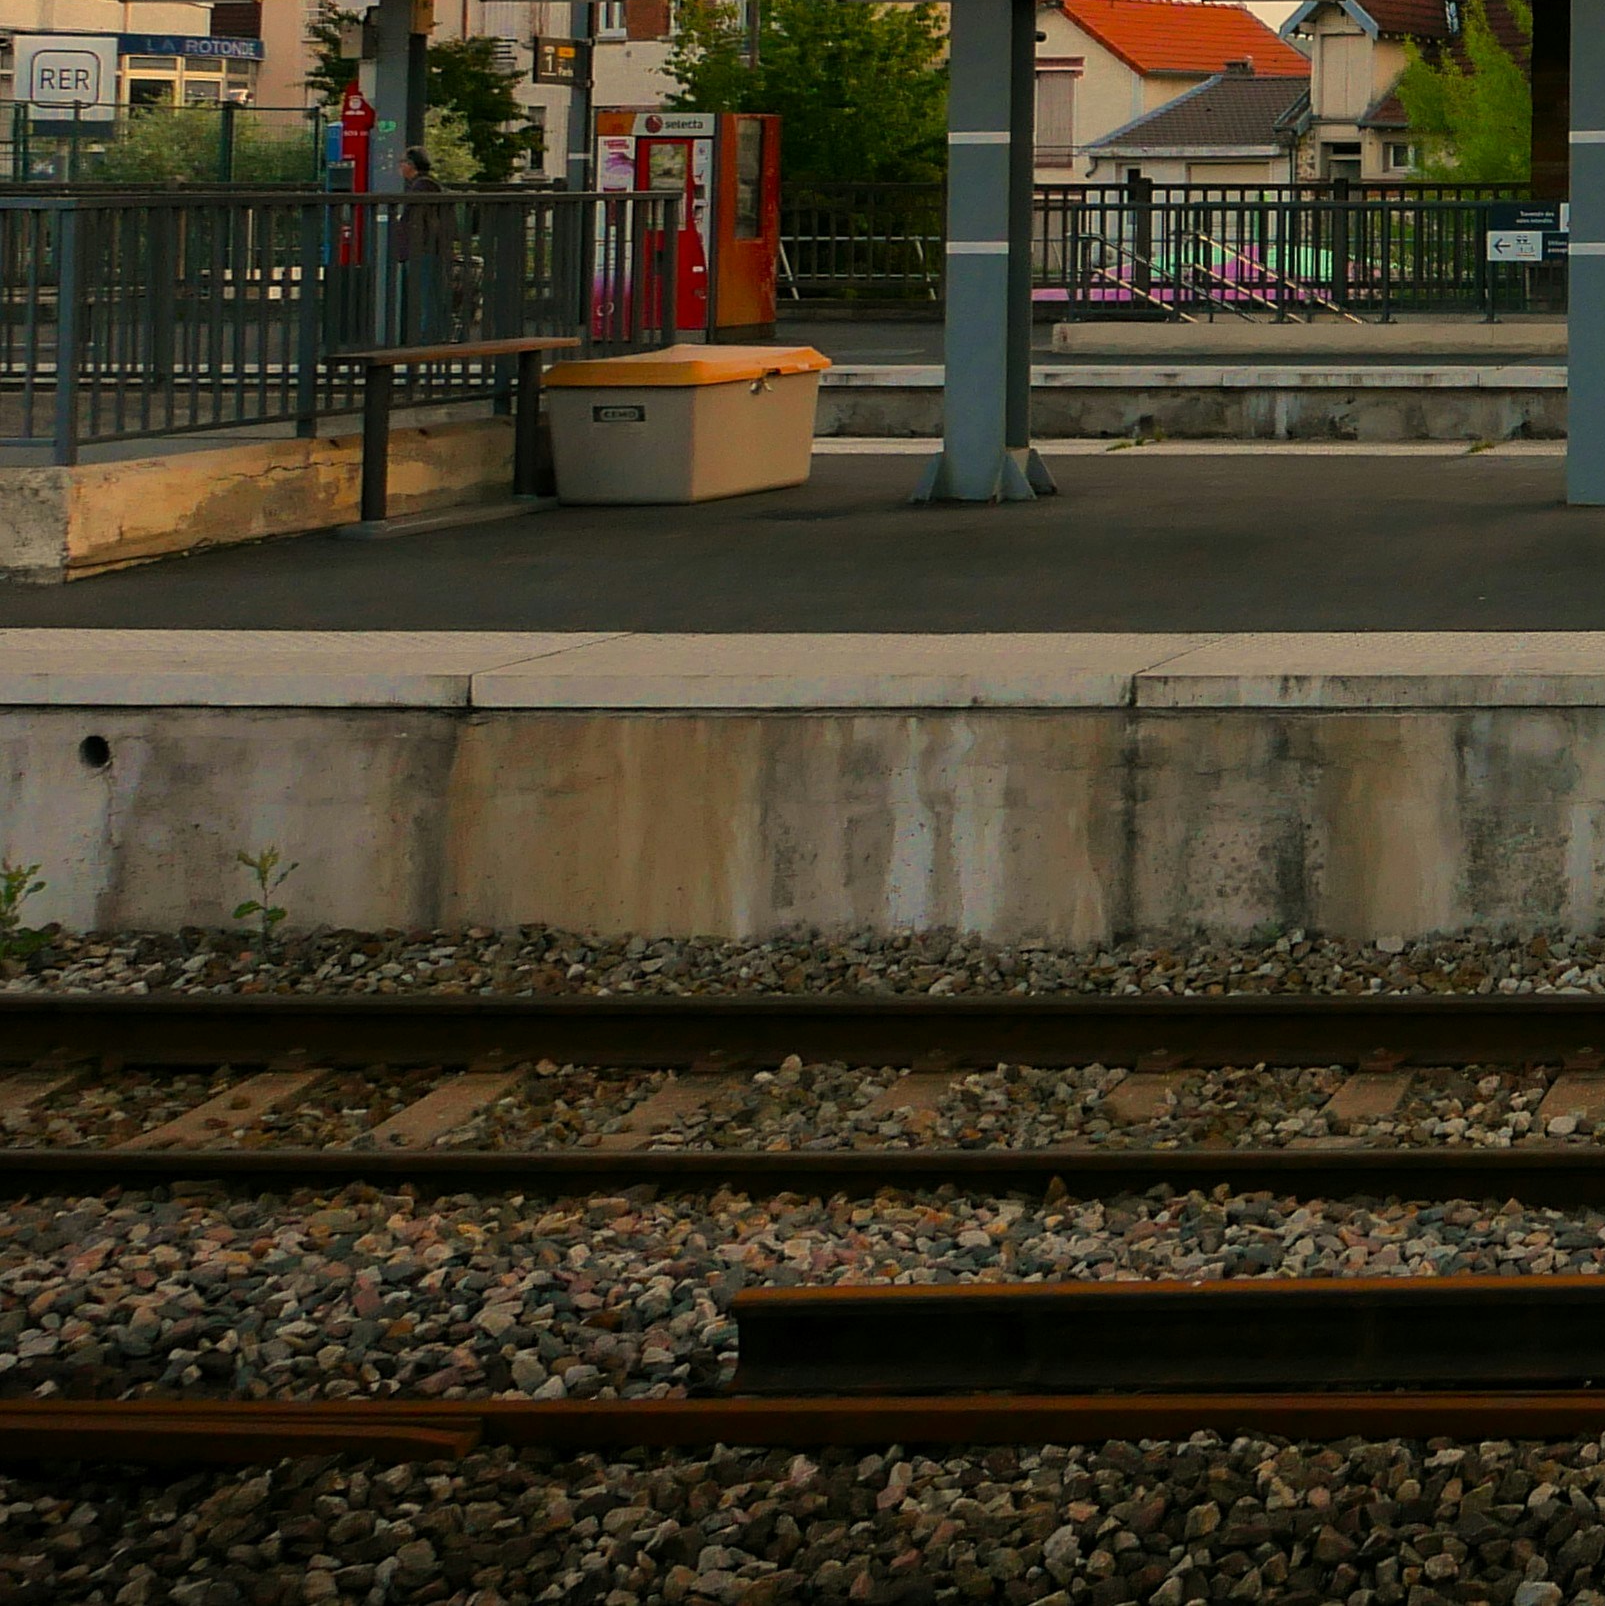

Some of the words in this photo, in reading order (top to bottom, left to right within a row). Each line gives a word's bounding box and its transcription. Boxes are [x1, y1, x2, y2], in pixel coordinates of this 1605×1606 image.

[146, 39, 176, 51] LA
[185, 39, 256, 56] ROTONDE
[39, 68, 91, 91] RER
[664, 119, 704, 129] selecta
